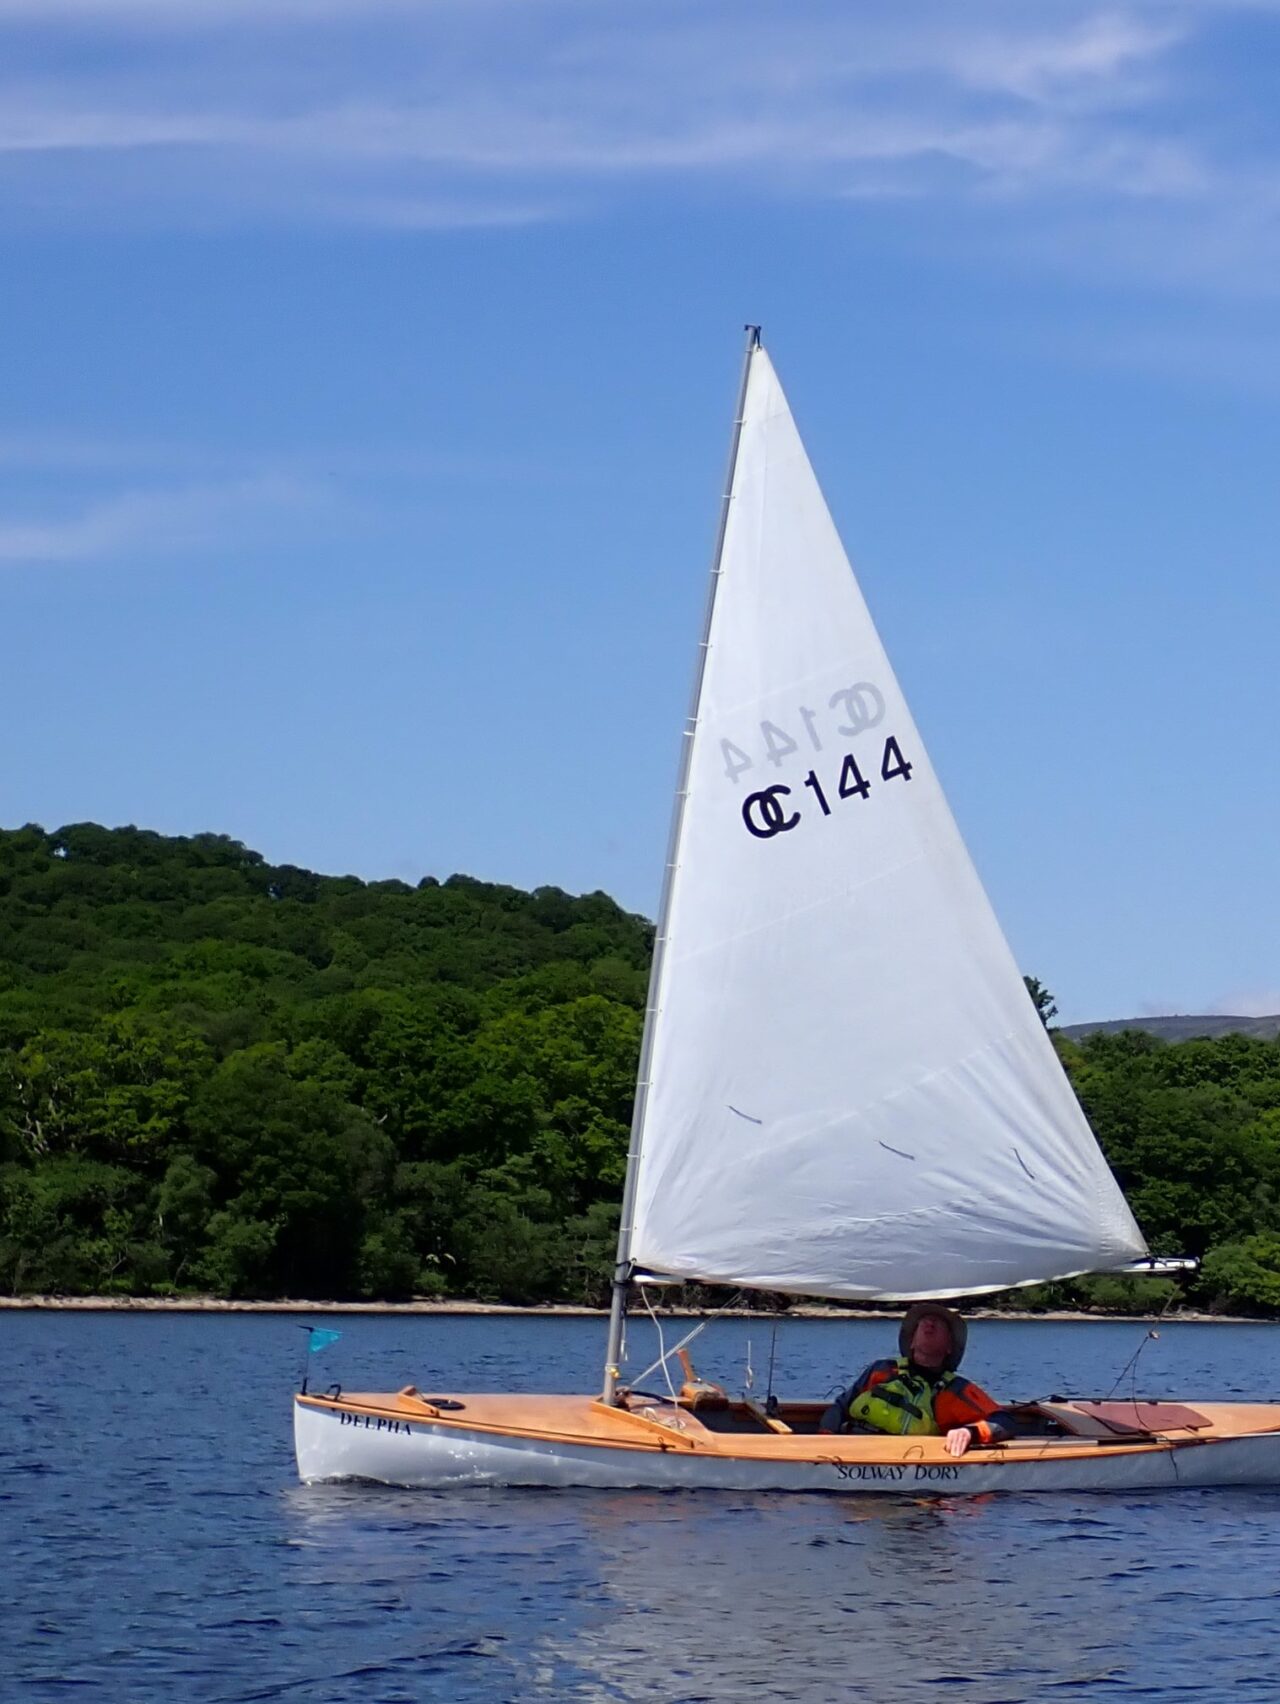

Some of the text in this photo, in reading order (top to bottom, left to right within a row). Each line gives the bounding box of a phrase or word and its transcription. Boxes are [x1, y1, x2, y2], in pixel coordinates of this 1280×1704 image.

[340, 1412, 411, 1435] DELPHA
[837, 1465, 962, 1480] SOLWAY DORY
